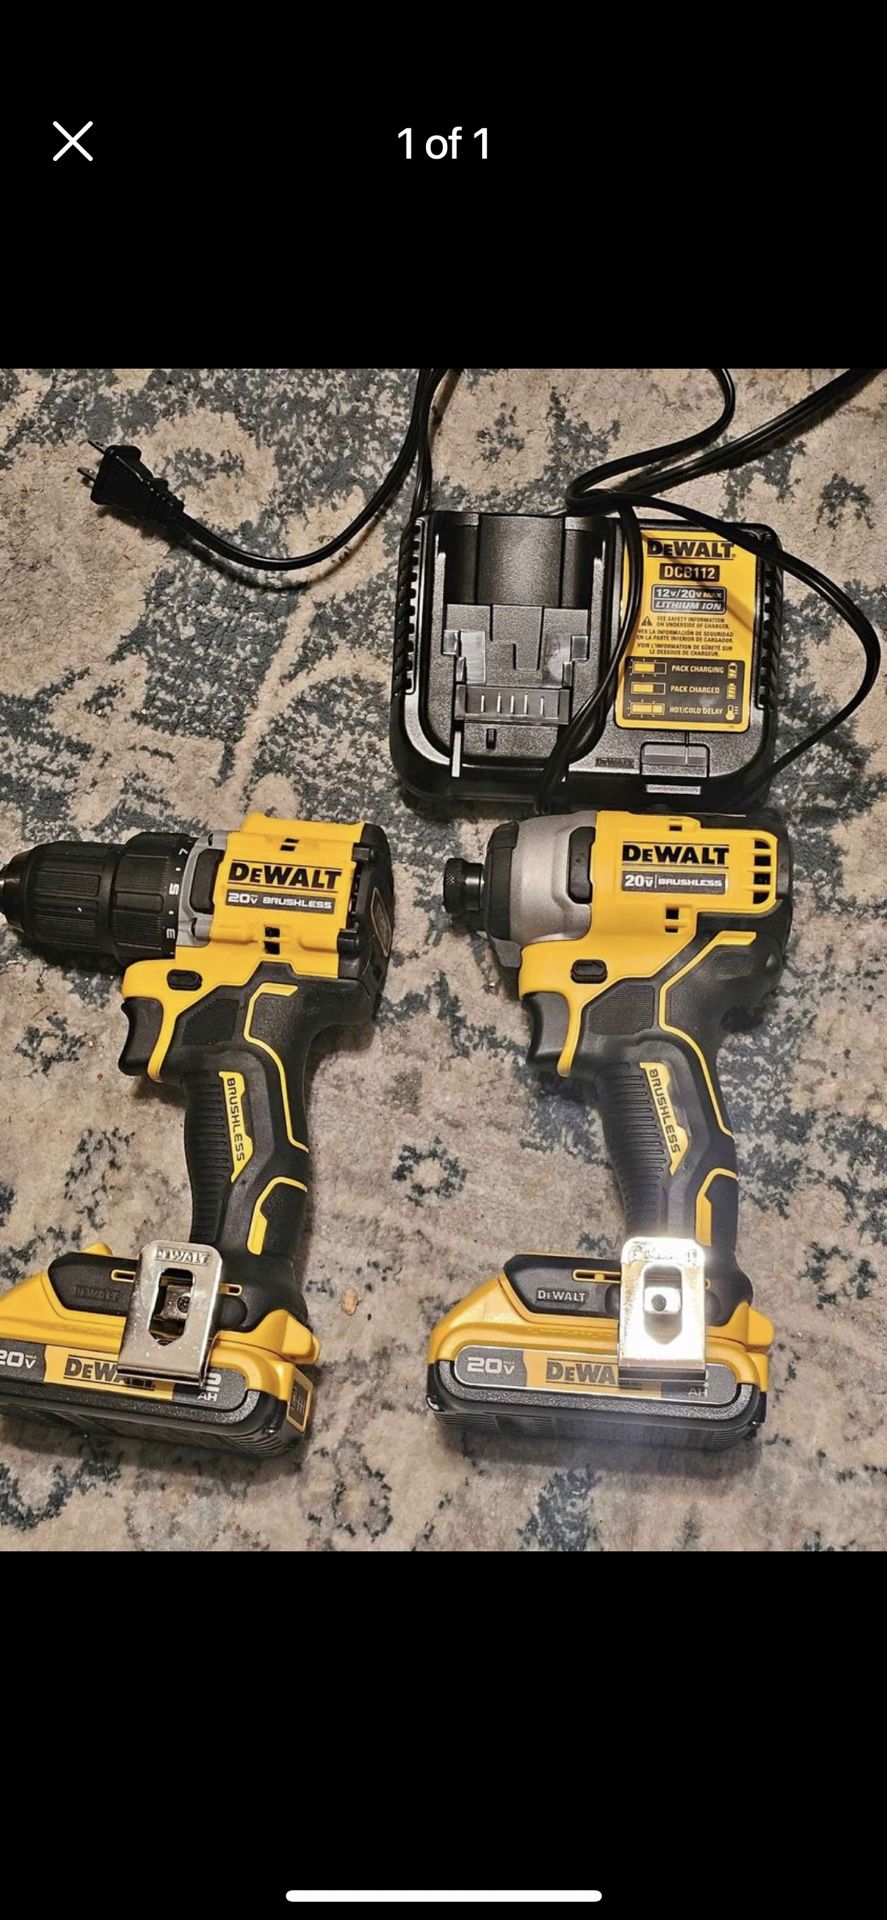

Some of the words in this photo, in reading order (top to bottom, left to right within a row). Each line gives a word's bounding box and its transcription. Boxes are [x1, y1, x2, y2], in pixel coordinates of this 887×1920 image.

[664, 565, 715, 579] DCB112
[655, 601, 699, 610] LITHIUM
[701, 602, 722, 610] ION
[671, 665, 689, 673] PACK
[690, 665, 725, 674] CHARGING
[670, 685, 688, 693] PACK
[689, 686, 720, 694] CHARGED
[669, 706, 702, 714] HOT/COLD
[702, 707, 723, 715] DELAY
[658, 878, 723, 887] BRUSHLESS
[262, 896, 332, 909] BRUSHLESS
[649, 1068, 681, 1154] BRUSHLESS
[227, 1077, 245, 1161] BRUSHLESS
[197, 1392, 218, 1402] AH
